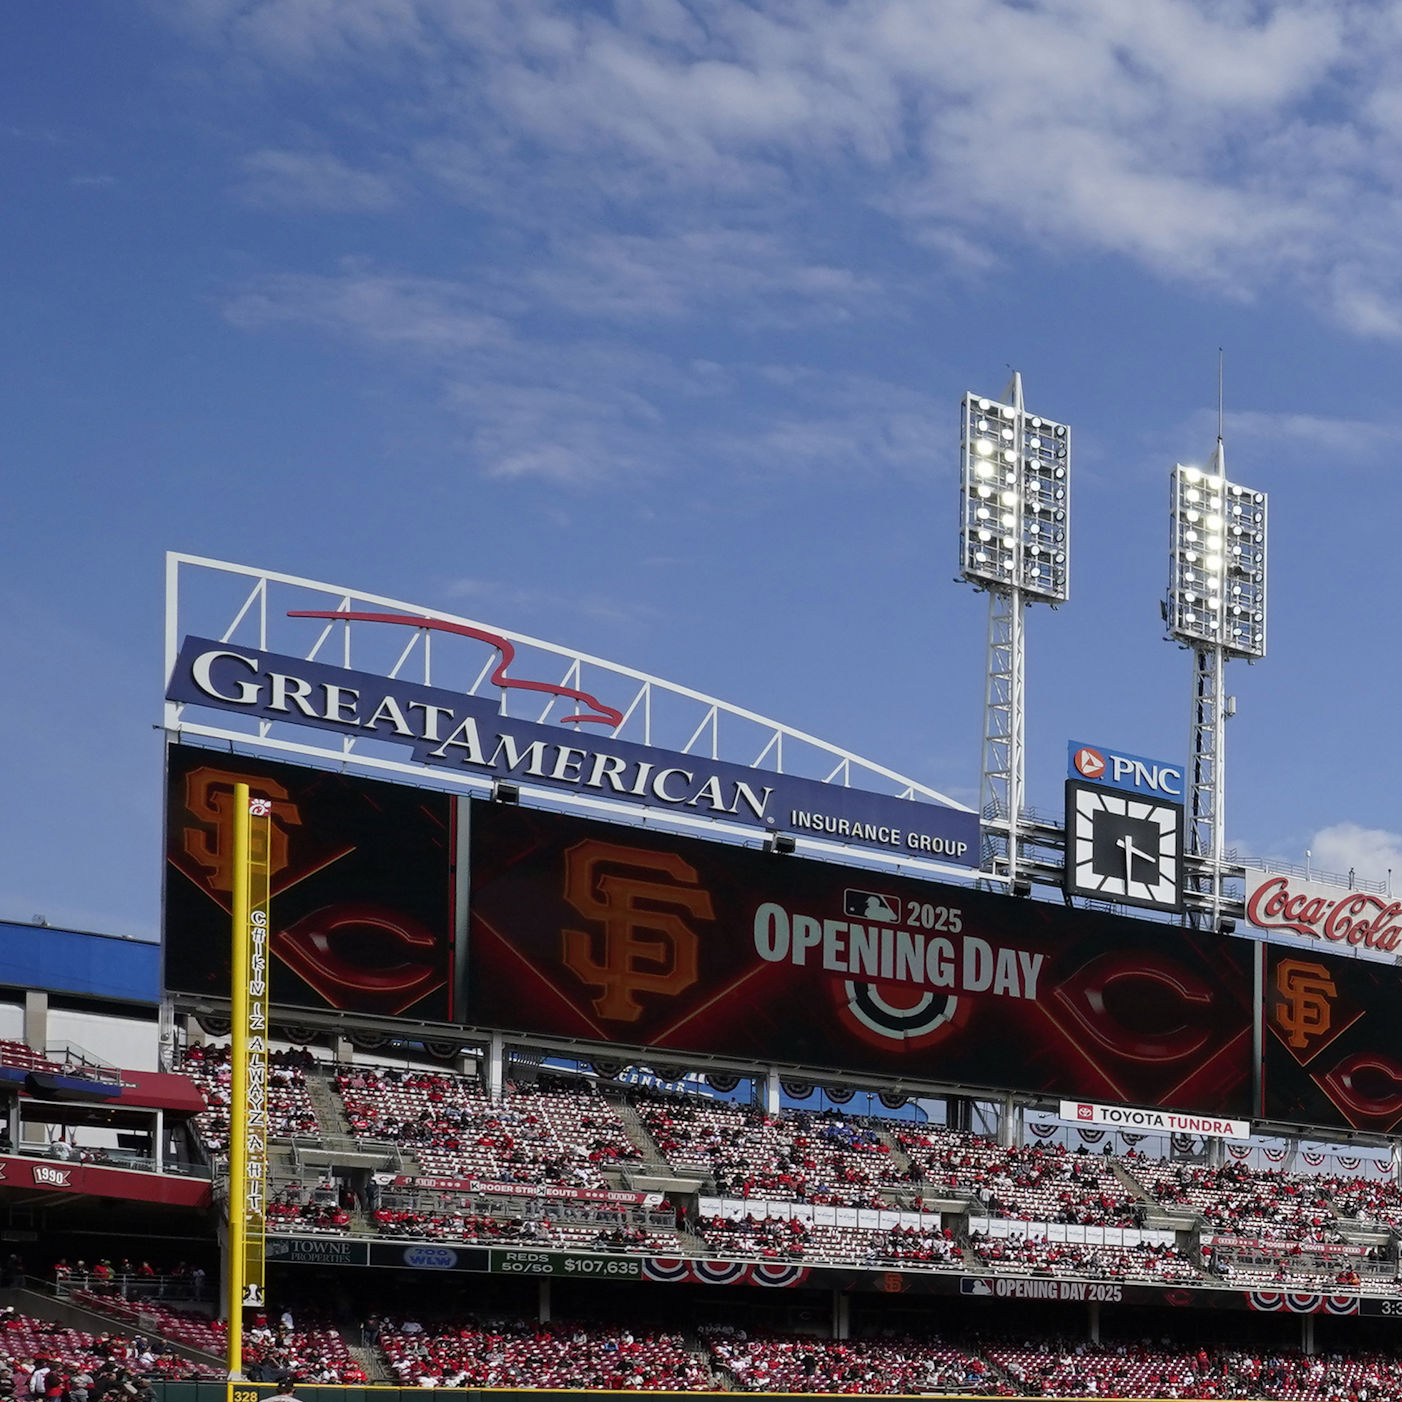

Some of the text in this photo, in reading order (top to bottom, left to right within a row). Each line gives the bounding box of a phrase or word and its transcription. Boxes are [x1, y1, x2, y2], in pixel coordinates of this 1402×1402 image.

[1112, 756, 1180, 796] PNC
[792, 811, 968, 858] INSURANCE GROUP
[907, 901, 963, 933] 2025
[249, 910, 266, 997] CHIKIN
[754, 902, 1044, 1000] OPENING DAY
[247, 1036, 266, 1127] ALWAYZ
[618, 1071, 686, 1093] CENTER
[1100, 1109, 1234, 1135] TOYOTA TUNDRA
[36, 1168, 64, 1185] 1990
[247, 1161, 264, 1211] HIT
[470, 1180, 512, 1194] KROGER
[291, 1240, 350, 1254] TOWNE
[291, 1252, 350, 1262] PROPERTIES
[506, 1252, 549, 1262] REDS
[502, 1262, 553, 1273] 50/50
[564, 1258, 639, 1275] $107,635
[996, 1279, 1123, 1302] OPENING DAY 2025
[234, 1392, 258, 1402] 328
